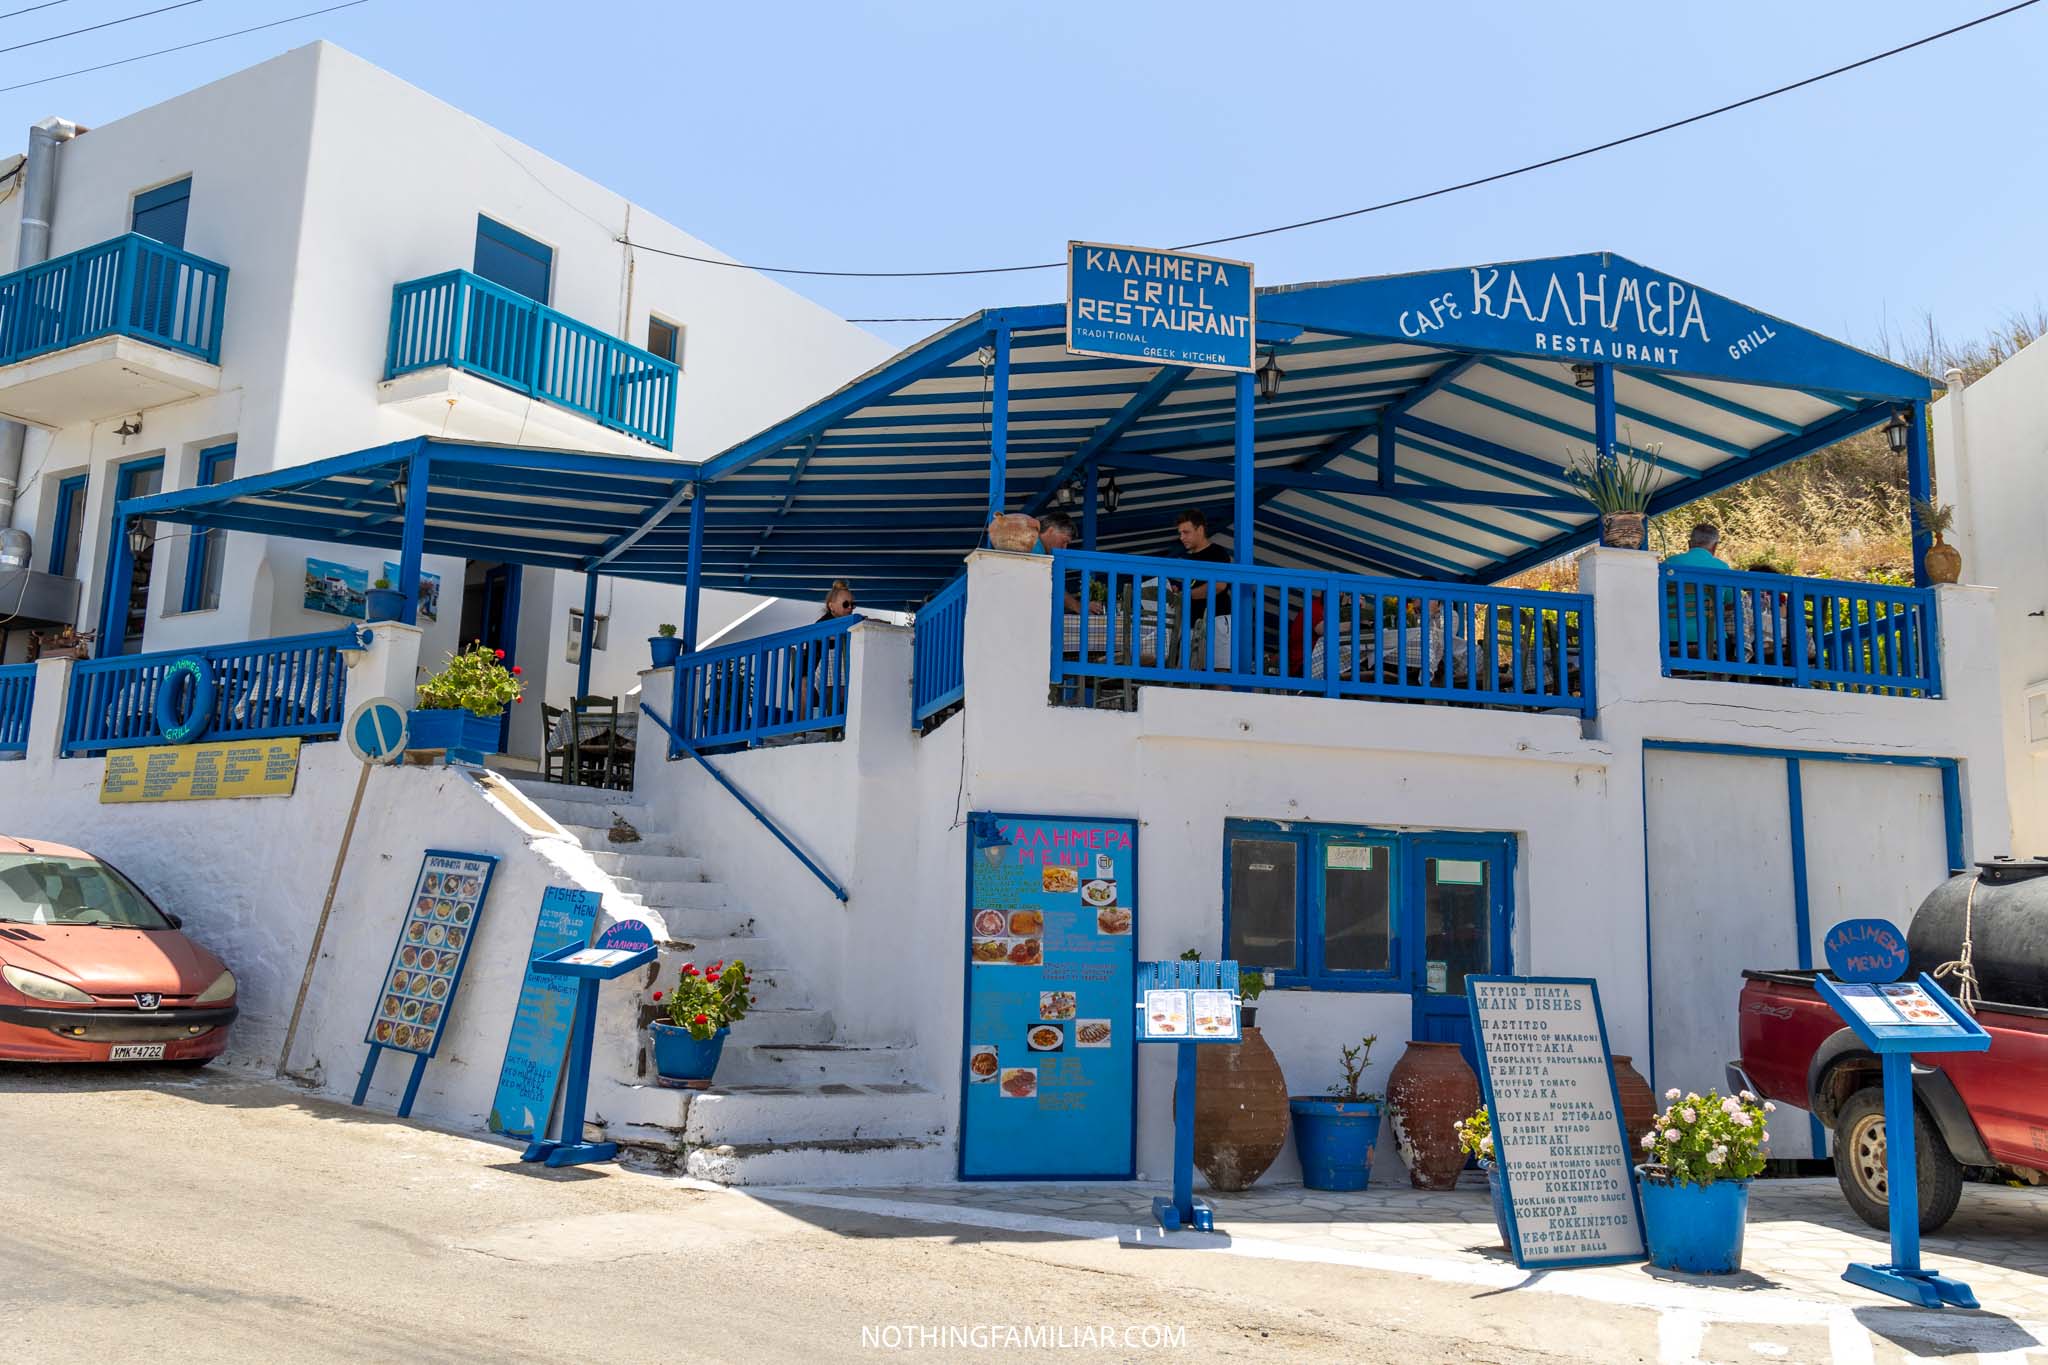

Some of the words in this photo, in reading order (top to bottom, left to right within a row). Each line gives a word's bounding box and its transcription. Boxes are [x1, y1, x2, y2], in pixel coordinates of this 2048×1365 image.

[1086, 248, 1230, 287] ΚΑΛΗΜΕΡΑ
[1123, 278, 1214, 310] GRILL
[1470, 266, 1711, 343] ΚΑΛΗΜΕΡΑ
[1078, 297, 1249, 338] RESTAURANT
[1399, 292, 1463, 338] CAFE
[1075, 327, 1148, 344] TRADITIONAL
[1728, 323, 1777, 361] GRILL
[1143, 347, 1176, 359] GREEK
[1182, 351, 1226, 364] KITCHEN
[1535, 332, 1679, 366] RESTAURANT
[165, 724, 191, 740] GRILL
[998, 824, 1133, 849] ΑΛΗΜΕΡΑ
[1019, 848, 1089, 867] MENU
[547, 886, 586, 903] FISHES
[1828, 925, 1905, 964] KALIMERA
[1847, 953, 1893, 972] MENU
[1480, 987, 1527, 997] ΚΥΡΙΩΣ
[1534, 988, 1570, 998] ΠΙΑΤΑ
[1477, 998, 1517, 1010] MAIN
[1526, 999, 1582, 1011] DISHES
[1482, 1020, 1548, 1030] ΠΑΣΤΙΤΣΟ
[1554, 1034, 1598, 1043] MAKARONI
[1486, 1042, 1574, 1053] ΠΑΠΟΥΤΣΑΚΙΑ
[1490, 1066, 1549, 1076] ΓΕΜΙΣΤΑ
[1540, 1079, 1577, 1087] TOMATO
[1494, 1089, 1557, 1099] ΜΟΥΣΑΚΑ
[1550, 1101, 1594, 1110] MOUSAKA
[1498, 1112, 1554, 1122] ΚΟΥΝΕΛΙ
[1512, 1126, 1545, 1134] RABBIT
[1554, 1125, 1591, 1133] STIFADO
[1550, 1144, 1620, 1157] ΚΟΚΚΙΝΙΣΤΟ
[1506, 1161, 1522, 1170] KID
[1525, 1161, 1547, 1169] GOAT
[1550, 1160, 1558, 1168] IN
[1559, 1159, 1591, 1168] TOMATO
[1595, 1158, 1622, 1167] SAUCE
[1508, 1169, 1607, 1181] ΓΟΥΡΟΥΝΟΠΟΥΛΟ
[1545, 1179, 1618, 1193] ΚΟΚΚΙΝΙΣΤΟ
[1513, 1196, 1556, 1206] SUCKLING
[1558, 1196, 1566, 1204] IN
[1567, 1195, 1599, 1204] TOMATO
[1601, 1193, 1626, 1202] SAUCE
[1515, 1205, 1577, 1218] ΚΟΚΚΟΡΑΣ
[1549, 1215, 1628, 1229] ΚΟΚΚΙΝΙΣΤΟΣ
[1523, 1229, 1601, 1243] ΚΕΦΤΕΔΑΚΙΑ
[1523, 1246, 1549, 1256] FRIED
[1553, 1245, 1576, 1253] MEAT
[1581, 1242, 1607, 1252] BALLS
